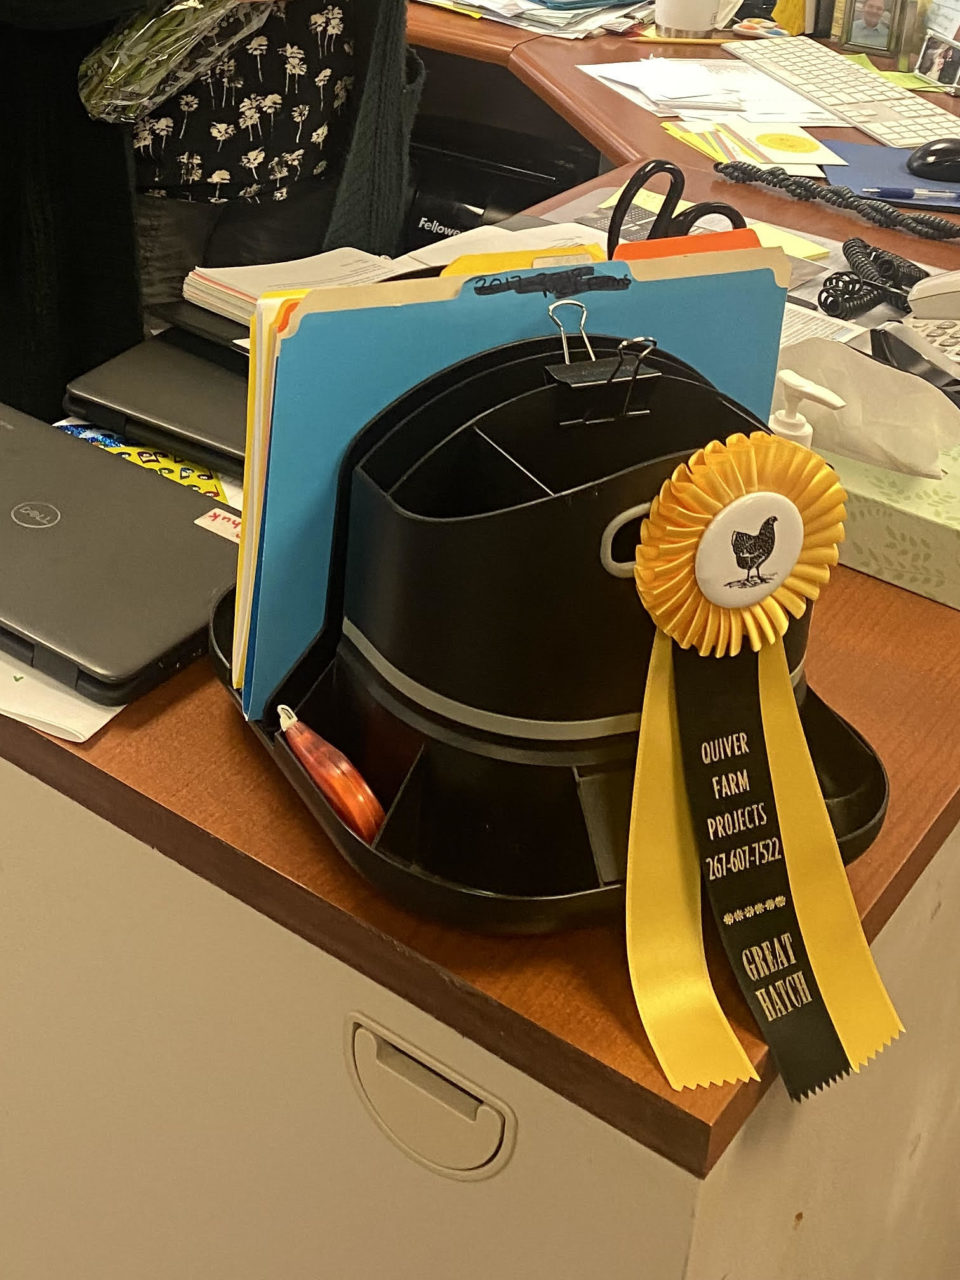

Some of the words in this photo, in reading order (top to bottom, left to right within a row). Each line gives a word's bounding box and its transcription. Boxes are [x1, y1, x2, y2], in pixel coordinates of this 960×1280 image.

[418, 217, 461, 236] Fellowe
[701, 732, 750, 764] QUIVER
[712, 769, 750, 800] FARM
[707, 802, 767, 841] PROJECTS
[705, 837, 782, 881] 267-607-7522
[742, 932, 797, 982] GREAT
[755, 970, 813, 1022] HATCH
